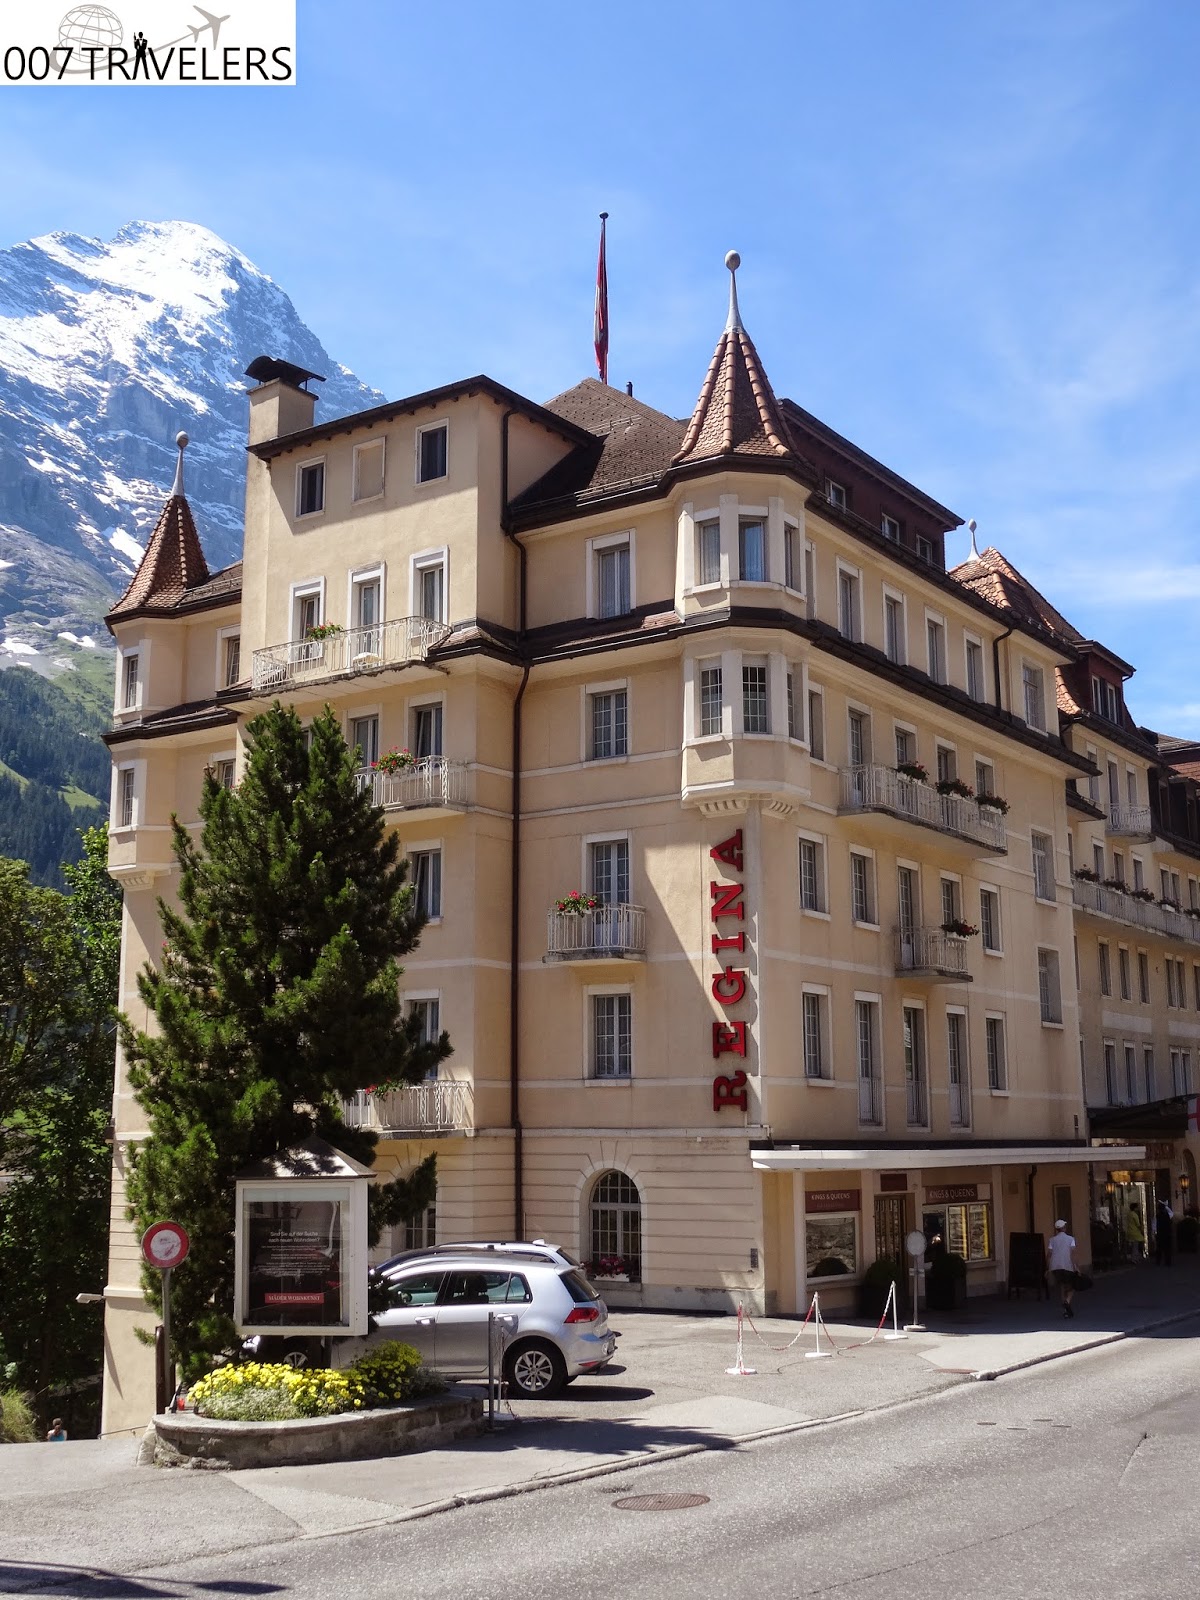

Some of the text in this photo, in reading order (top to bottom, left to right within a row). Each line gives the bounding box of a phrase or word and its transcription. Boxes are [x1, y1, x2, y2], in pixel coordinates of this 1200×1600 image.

[709, 828, 748, 1112] REGINA
[929, 1189, 944, 1199] KINGS
[950, 1188, 975, 1199] QUEENS
